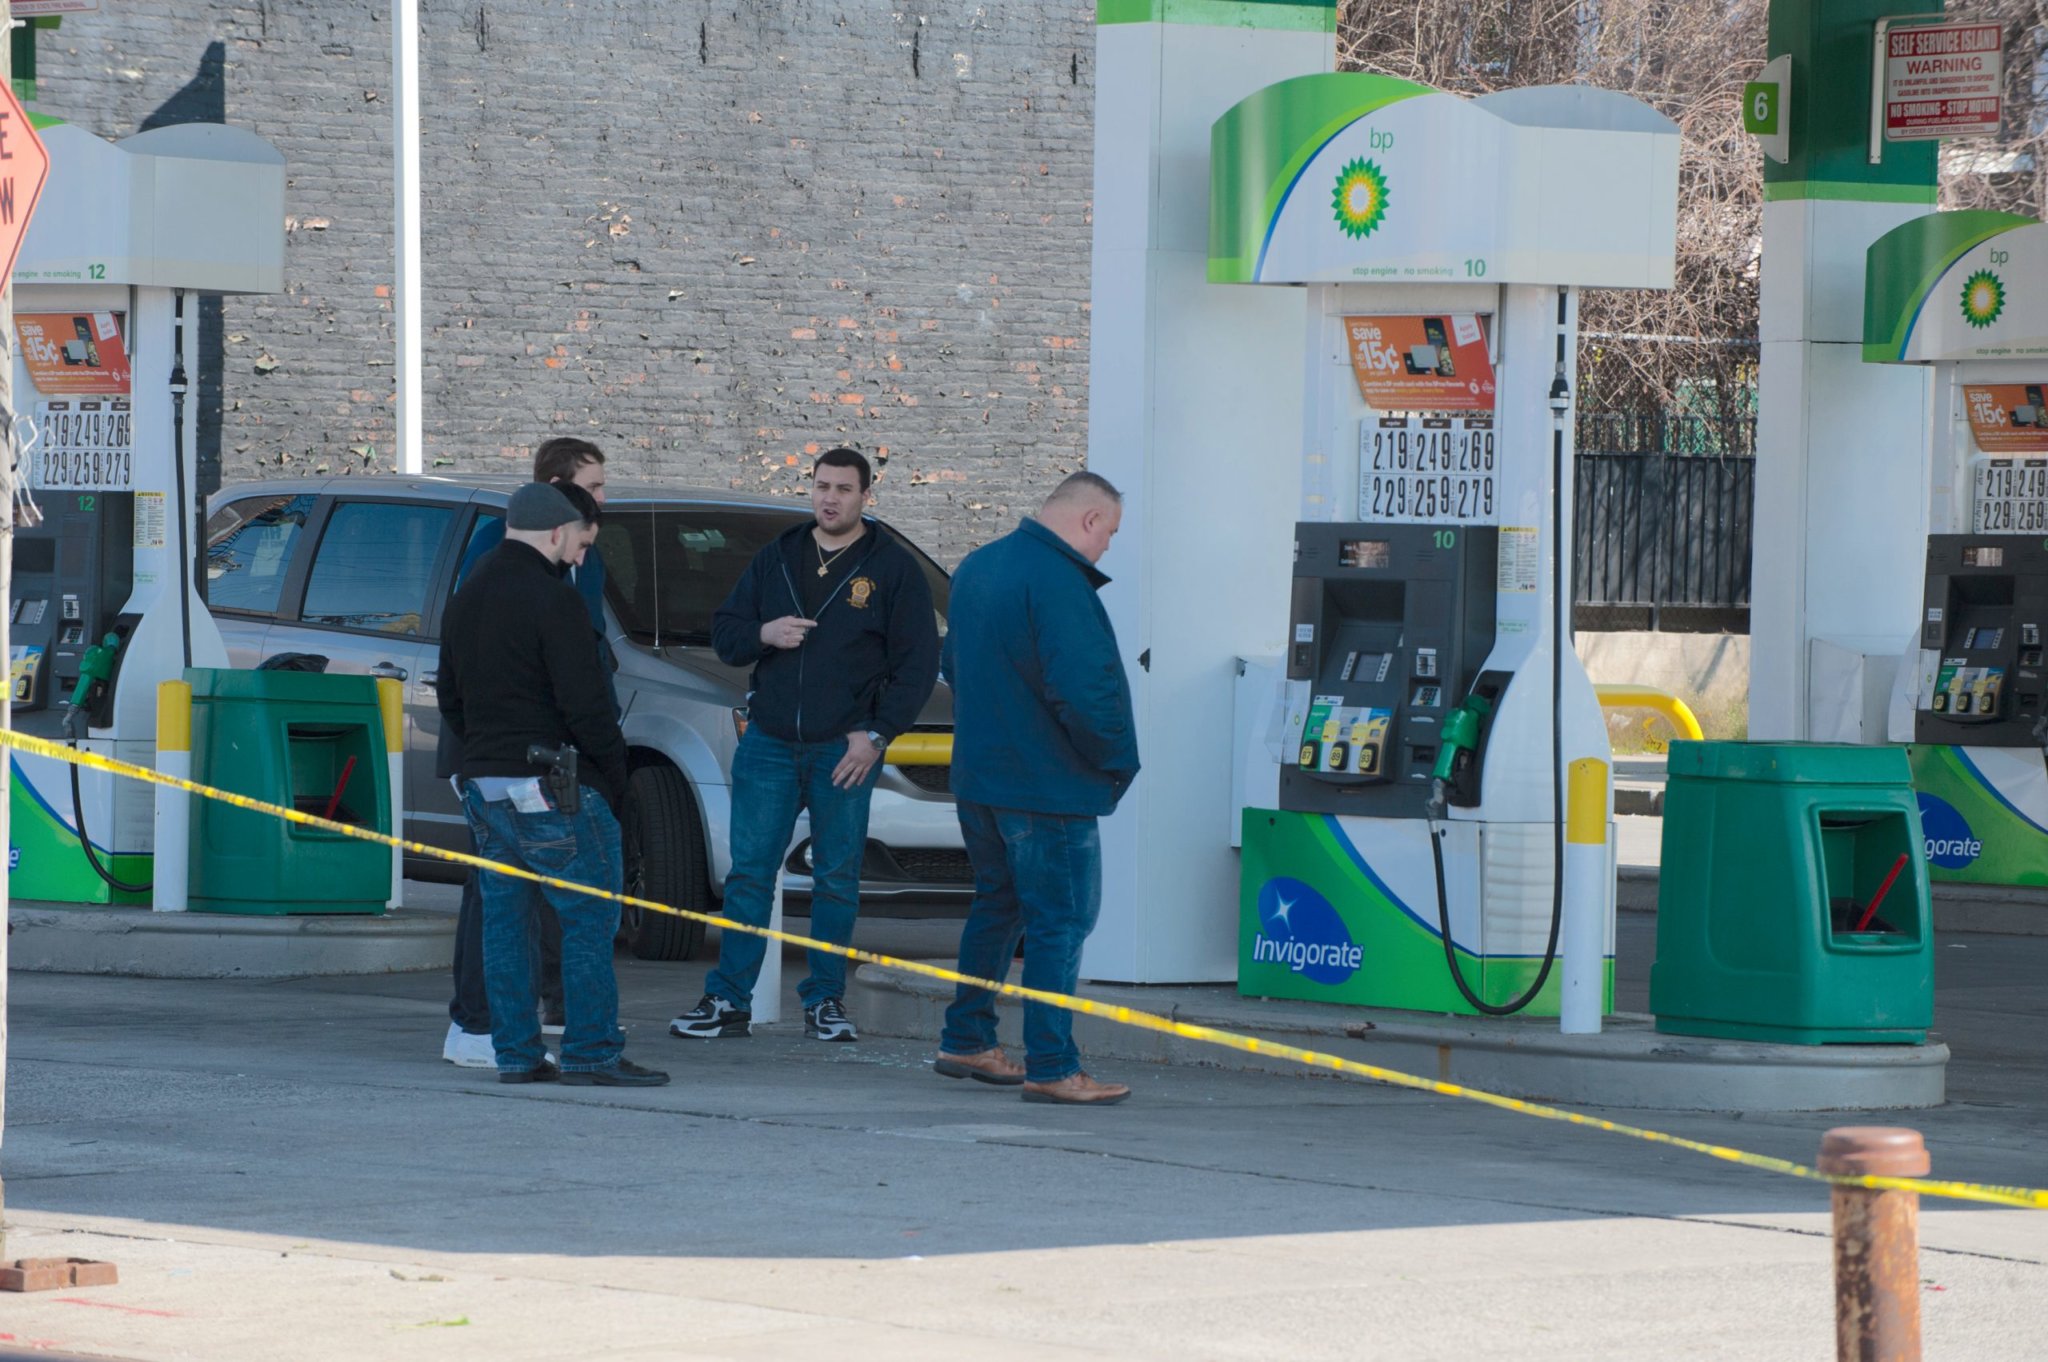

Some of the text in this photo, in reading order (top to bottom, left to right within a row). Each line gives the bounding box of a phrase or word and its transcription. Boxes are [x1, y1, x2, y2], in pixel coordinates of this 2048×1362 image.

[1892, 28, 1998, 56] SELF SERVICE ISLAND
[1907, 56, 1982, 74] WARNING
[1754, 92, 1768, 120] 6
[1890, 99, 1996, 118] NO SMOKING STOP MOTOR
[1370, 126, 1394, 152] bp
[1352, 266, 1369, 276] stop
[1370, 266, 1397, 277] engine
[1416, 266, 1453, 277] smoking
[1464, 258, 1486, 278] 10
[1990, 248, 2009, 268] bp
[88, 264, 106, 280] 12
[1352, 327, 1382, 340] save
[26, 337, 59, 366] 15¢
[1358, 341, 1400, 375] 15¢
[1969, 392, 1992, 402] save
[1974, 402, 2006, 428] 15¢
[77, 496, 95, 511] 12
[1433, 531, 1454, 549] 10
[1254, 934, 1362, 970] Invigorate
